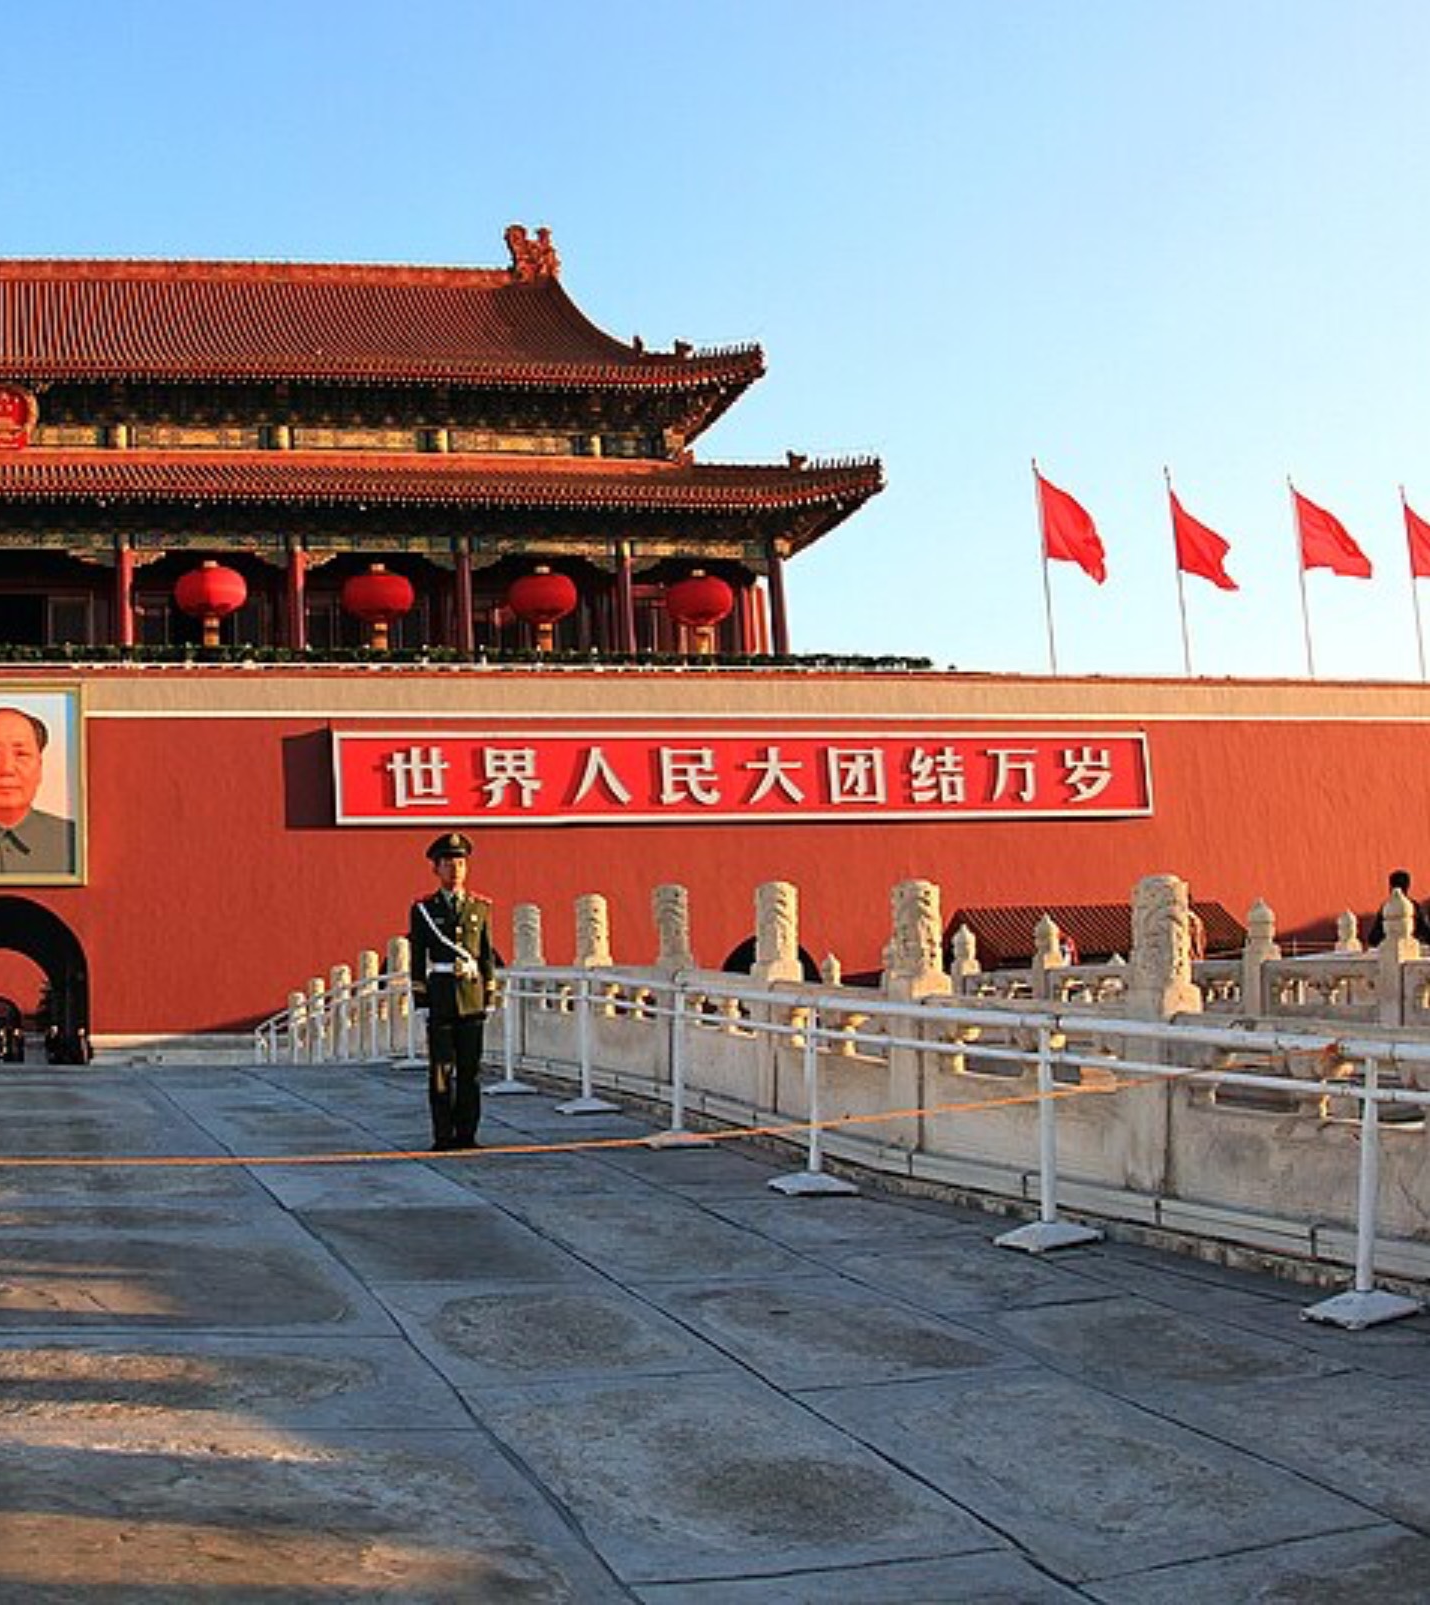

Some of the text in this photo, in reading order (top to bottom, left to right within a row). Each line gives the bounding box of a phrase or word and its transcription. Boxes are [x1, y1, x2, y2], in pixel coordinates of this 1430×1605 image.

[384, 746, 1115, 808] 世界人民大团结万岁
